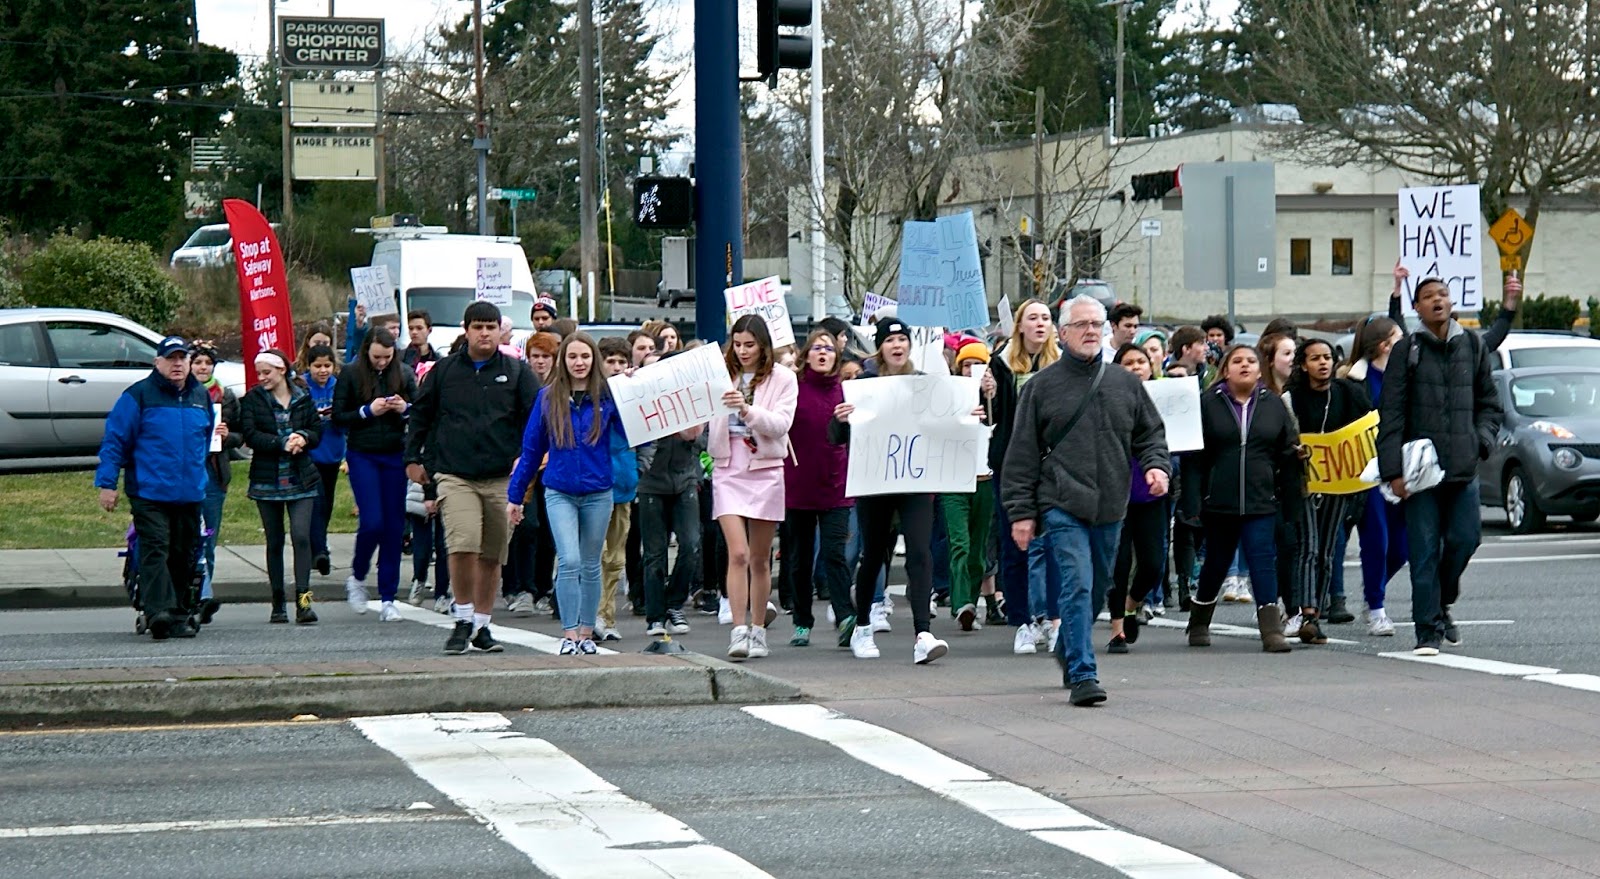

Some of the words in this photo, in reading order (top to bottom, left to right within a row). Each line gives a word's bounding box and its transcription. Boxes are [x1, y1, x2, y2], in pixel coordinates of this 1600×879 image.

[286, 23, 378, 34] PARKWOOD
[286, 34, 378, 49] SHOPPING
[296, 49, 368, 62] CENTER
[295, 138, 327, 147] AMORE
[332, 138, 371, 147] PETCARE
[1410, 190, 1455, 219] WE
[239, 241, 259, 259] Shop
[259, 236, 271, 254] at
[1403, 223, 1472, 258] HAVE
[243, 258, 272, 277] Safeway
[1426, 261, 1439, 276] A
[731, 281, 778, 309] LOVE
[866, 294, 877, 304] NO
[1403, 275, 1476, 309] VCE
[639, 381, 716, 432] HATE!
[885, 434, 977, 486] RIGHTS
